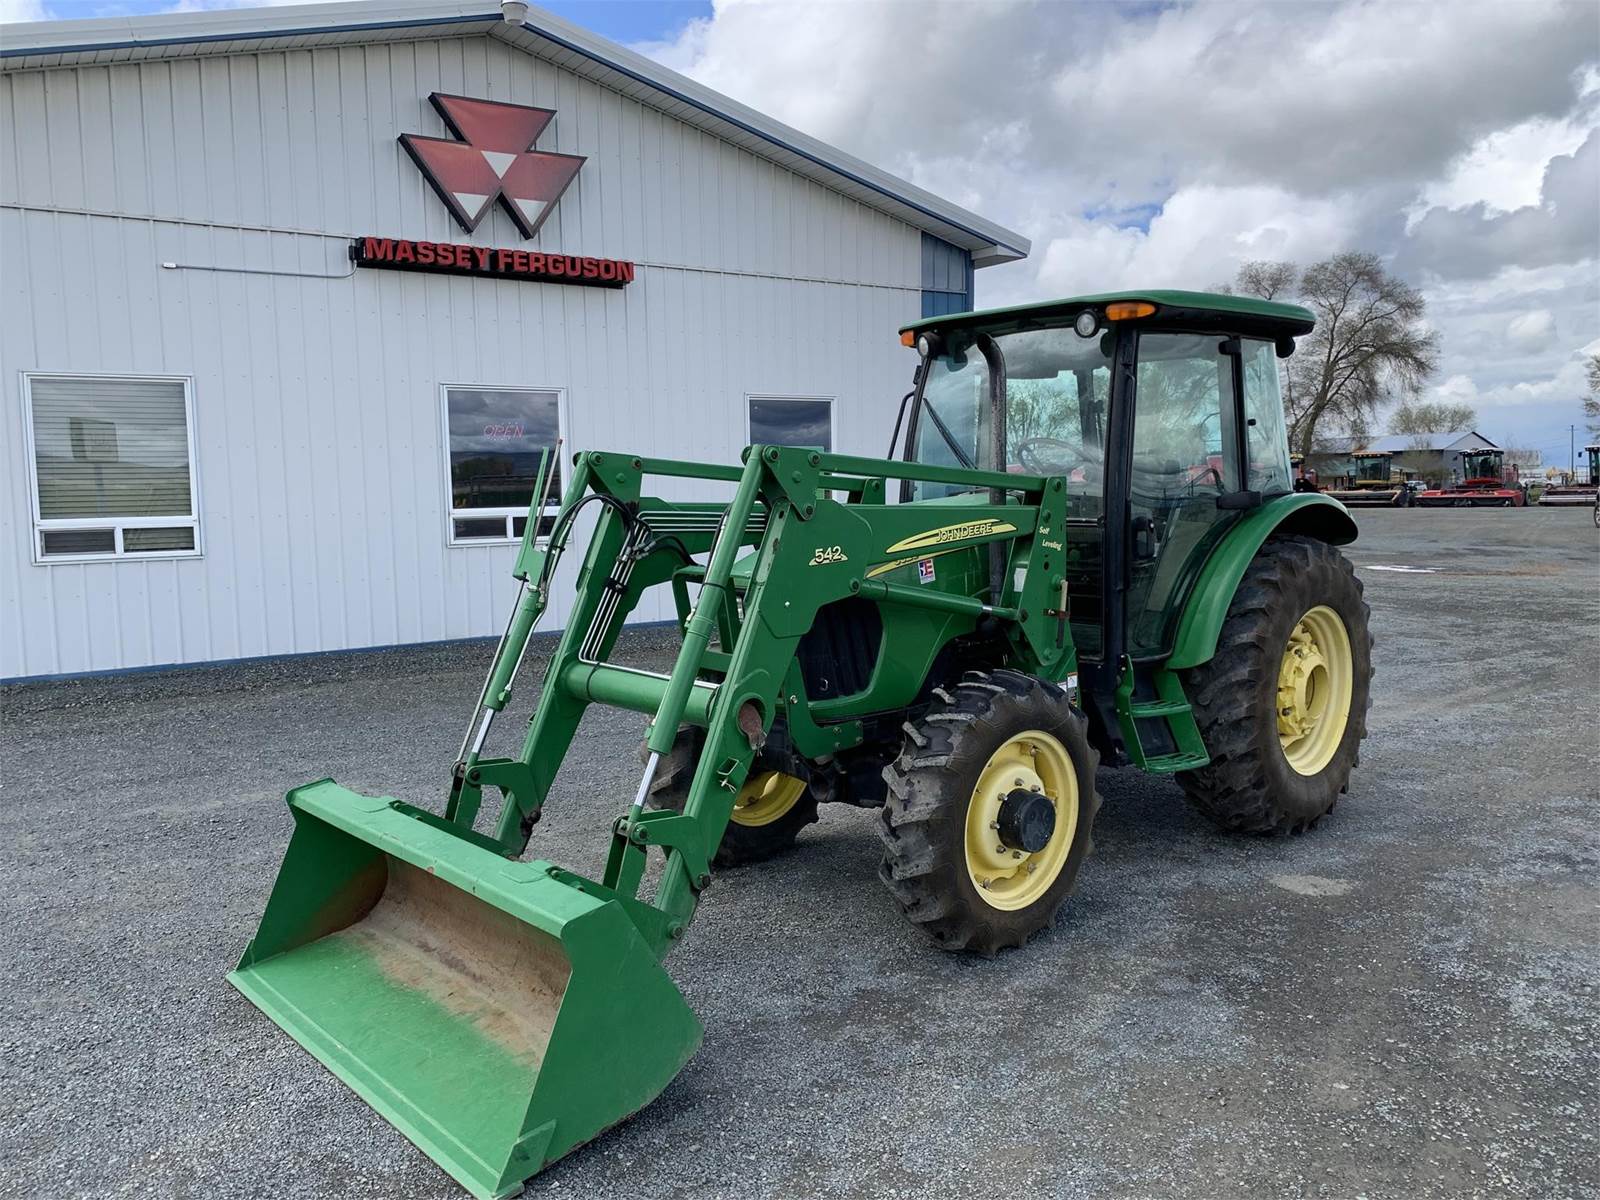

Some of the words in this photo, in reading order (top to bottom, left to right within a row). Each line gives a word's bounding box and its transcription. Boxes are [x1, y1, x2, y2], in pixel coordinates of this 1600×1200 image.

[365, 237, 490, 270] MASSEY
[498, 249, 635, 283] FERGUSON
[484, 424, 525, 440] OPEN
[937, 526, 961, 542] JOHN
[961, 523, 993, 538] DEERE
[1039, 526, 1051, 535] Self
[1042, 540, 1063, 551] Leveling
[815, 546, 842, 563] 542
